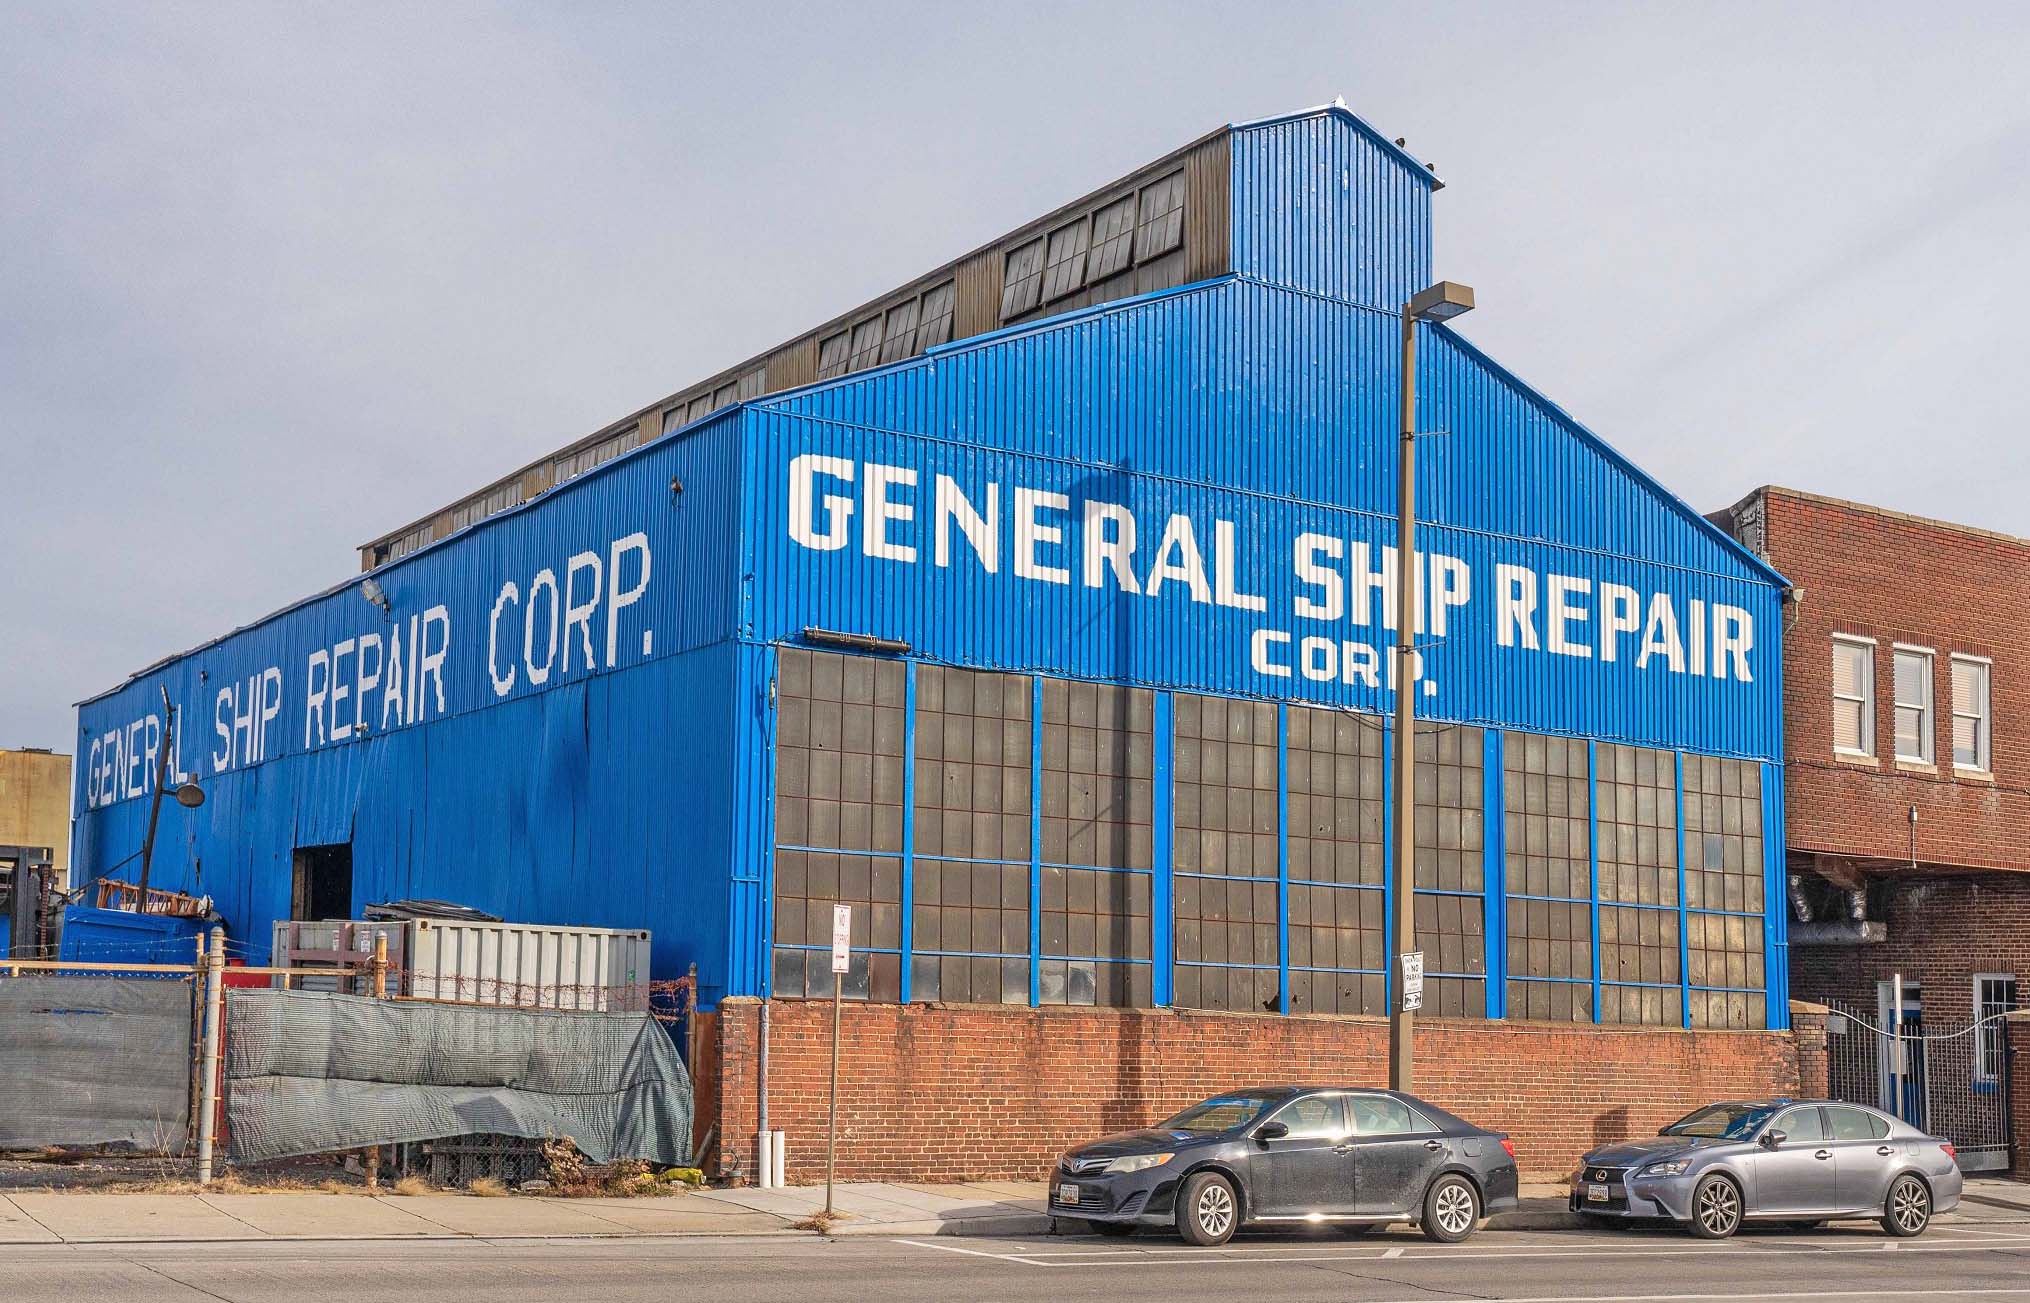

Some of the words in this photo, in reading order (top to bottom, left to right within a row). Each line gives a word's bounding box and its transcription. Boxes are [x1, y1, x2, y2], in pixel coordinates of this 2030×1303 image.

[87, 703, 188, 809] GENERAL
[211, 666, 282, 773] SHIP
[304, 604, 450, 749] REPAIR
[488, 531, 653, 697] CORP.
[788, 453, 1267, 613] GENERAL
[1292, 531, 1471, 638] SHIP
[1495, 562, 1753, 683] REPAIR
[1250, 628, 1438, 698] CORP.
